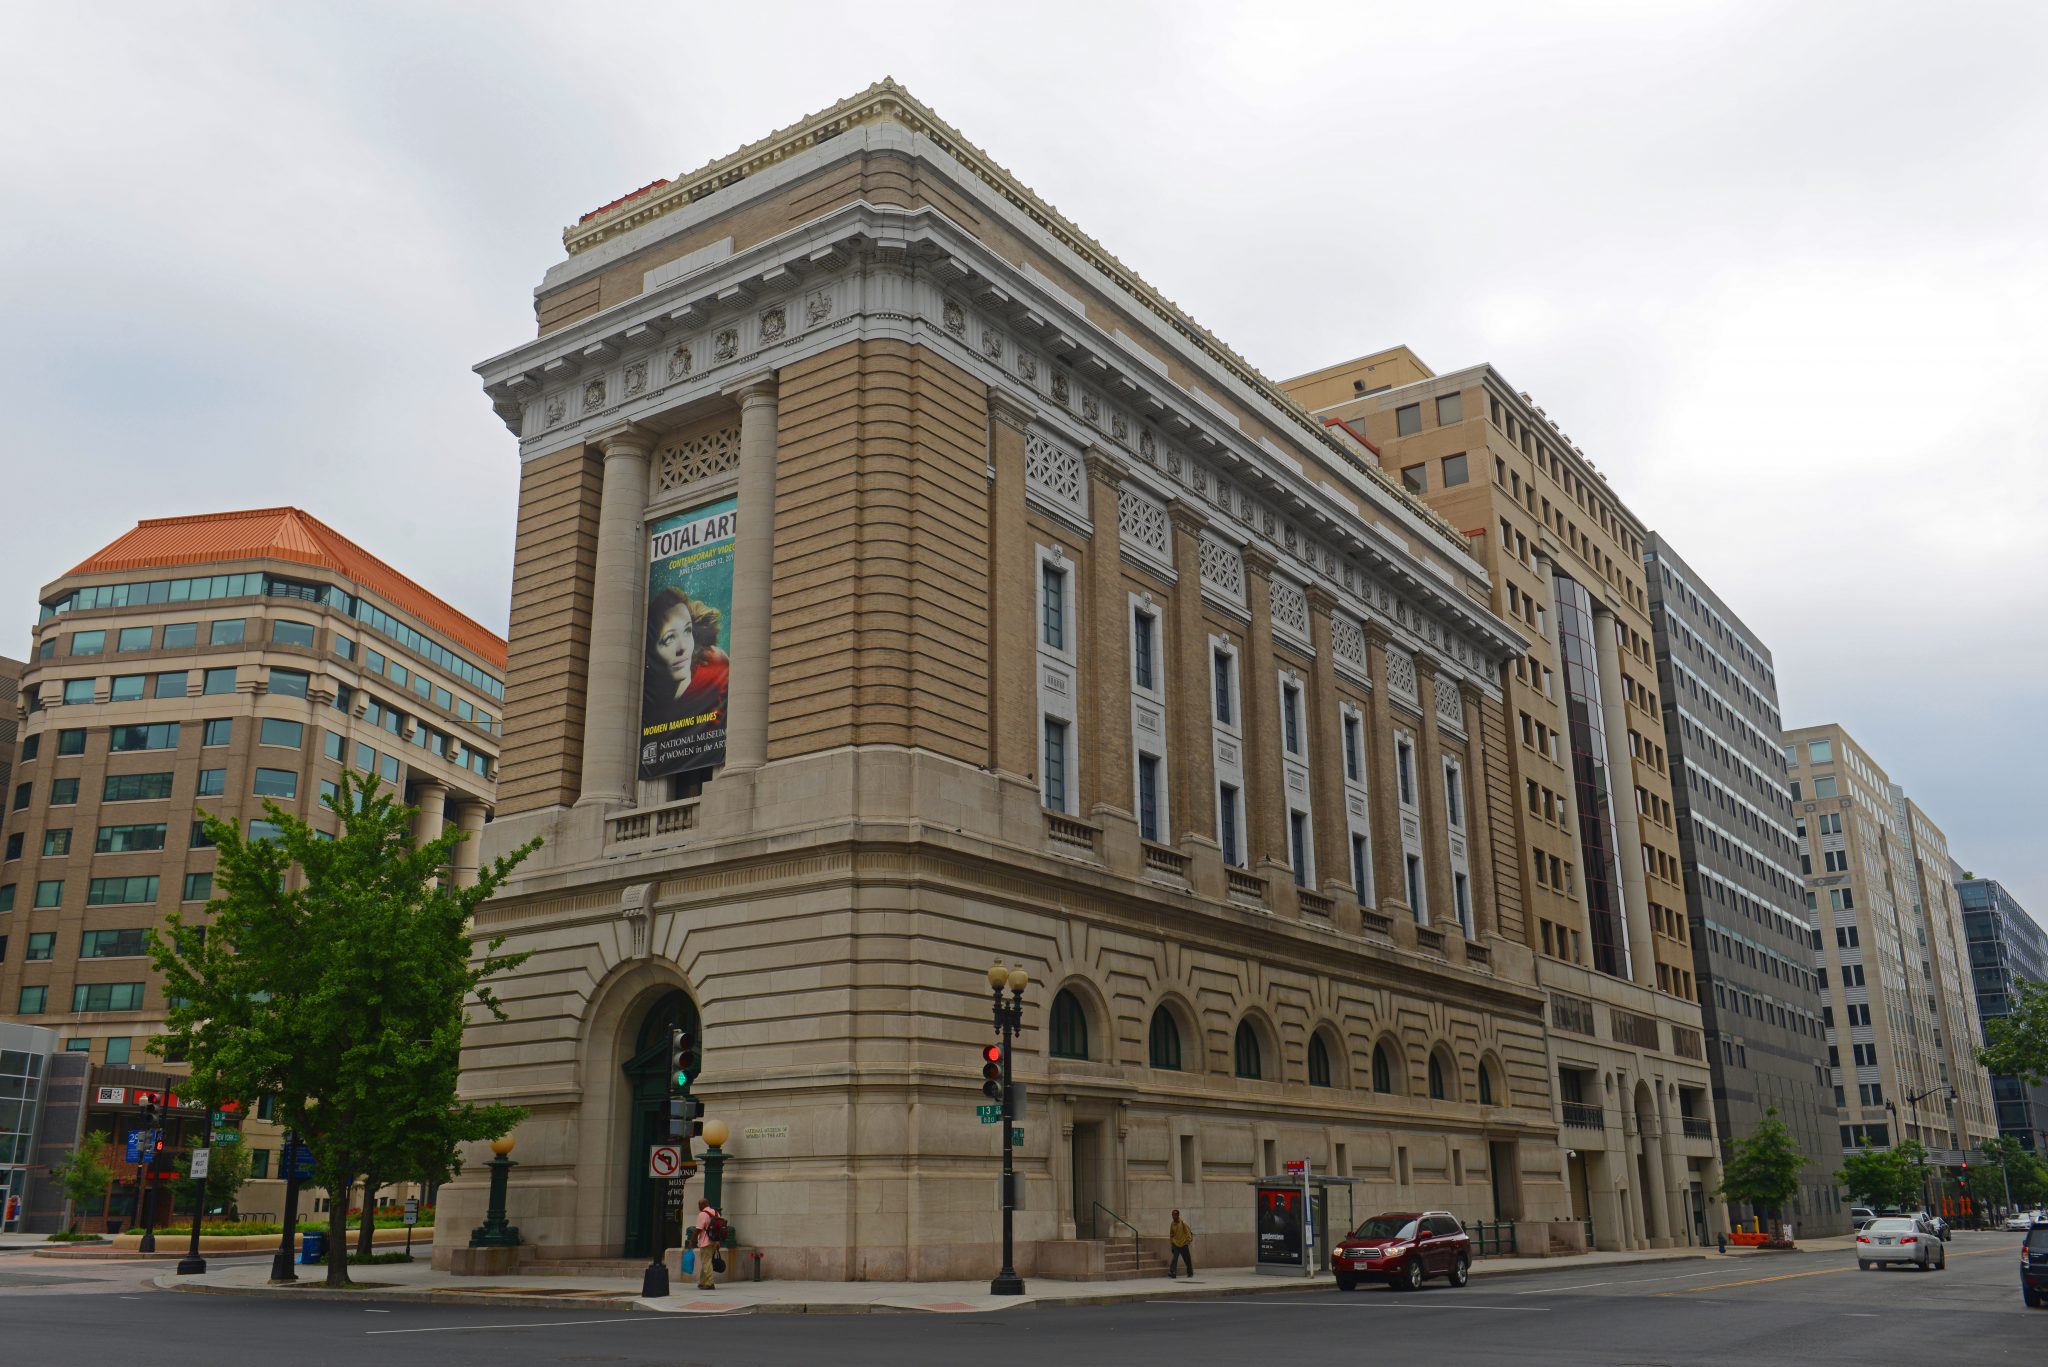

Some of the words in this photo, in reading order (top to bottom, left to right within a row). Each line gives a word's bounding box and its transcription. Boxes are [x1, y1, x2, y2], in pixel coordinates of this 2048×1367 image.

[652, 524, 700, 558] TOTAL
[704, 512, 737, 542] ART
[668, 548, 717, 570] CONTEMPORARY
[678, 567, 691, 578] JUNE
[643, 724, 667, 736] WOMEN
[669, 717, 694, 731] MAKING
[696, 711, 718, 726] WAVES
[659, 752, 667, 763] of
[666, 746, 694, 760] WOMEN
[703, 743, 713, 753] the
[660, 736, 695, 750] NATIONAL
[982, 1106, 991, 1115] 13
